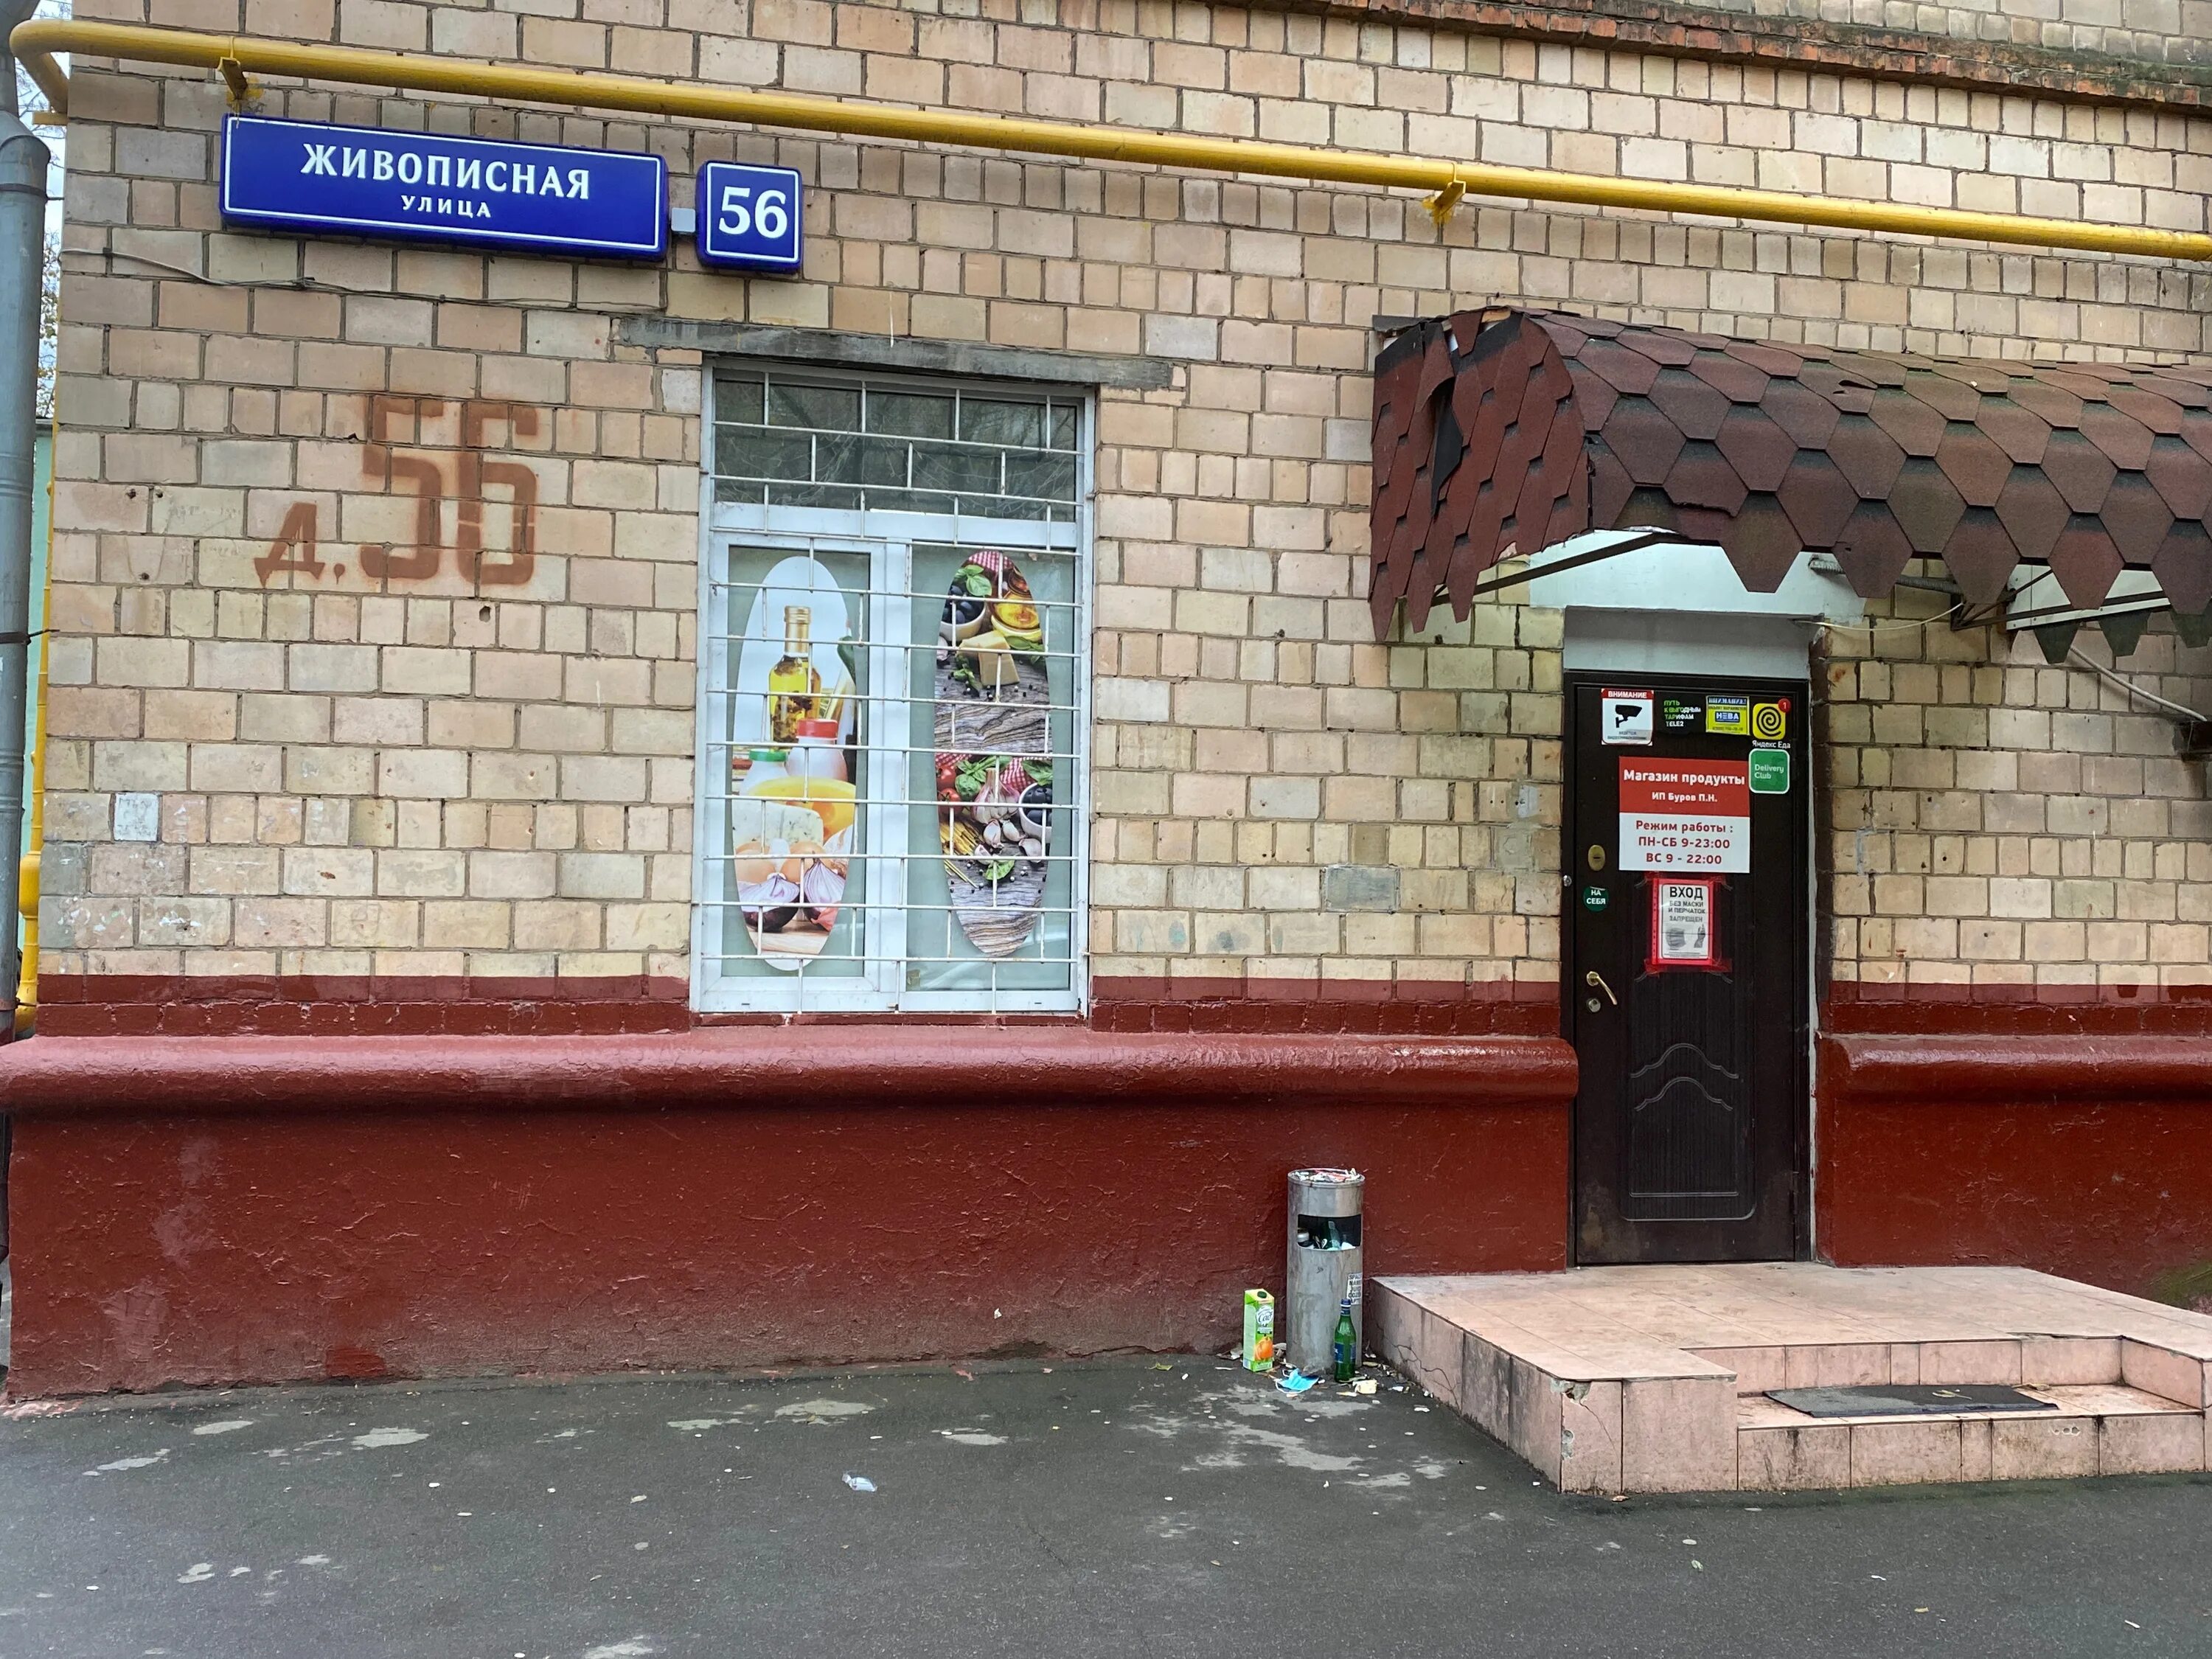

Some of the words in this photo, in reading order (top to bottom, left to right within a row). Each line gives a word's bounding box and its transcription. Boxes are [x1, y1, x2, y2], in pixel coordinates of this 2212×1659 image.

[299, 142, 590, 200] ЖИВОПИСНАЯ
[400, 194, 492, 219] УЛИЦА
[717, 186, 788, 240] 56
[1607, 690, 1647, 698] ВНИМАНИЕ
[1752, 740, 1777, 748] Яндекс
[1778, 741, 1791, 749] Еда
[1754, 764, 1784, 773] Delivery
[1624, 769, 1678, 782] Магазин
[1682, 773, 1745, 786] продукты
[1652, 792, 1666, 800] ИП
[1668, 793, 1696, 802] Буров
[1698, 793, 1718, 802] П.Н.
[1635, 820, 1677, 831] Режим
[1638, 836, 1677, 847] ПН-СБ
[1681, 838, 1731, 849] 9-23:00
[1646, 852, 1662, 863] ВС
[1666, 853, 1673, 863] 9
[1686, 854, 1722, 864] 22:00
[1669, 886, 1703, 900] ВХОД
